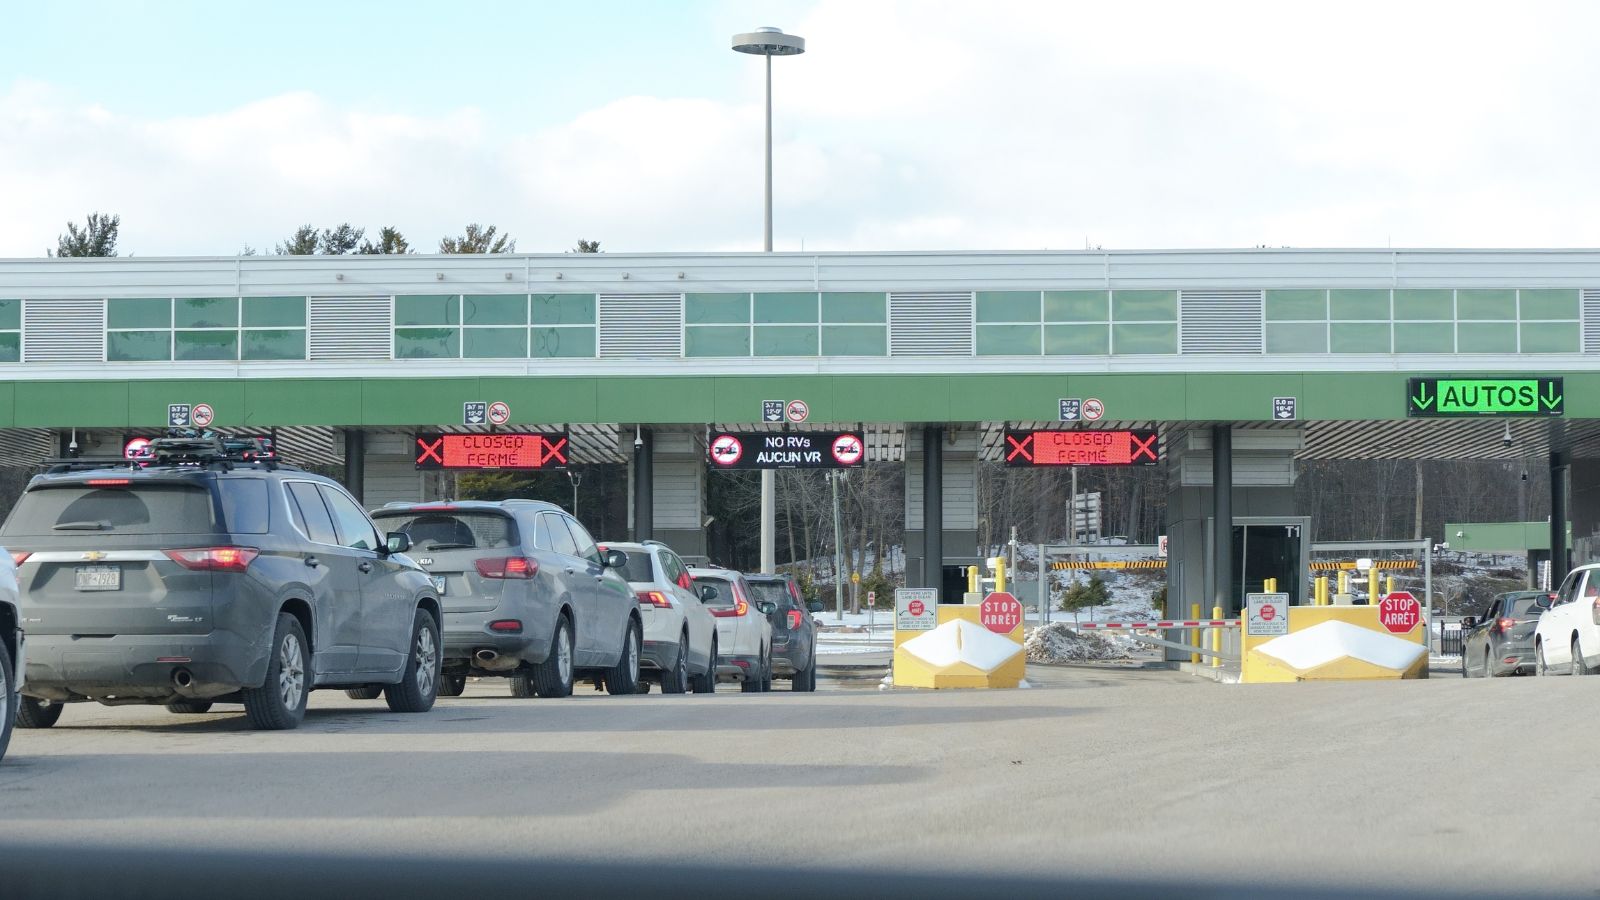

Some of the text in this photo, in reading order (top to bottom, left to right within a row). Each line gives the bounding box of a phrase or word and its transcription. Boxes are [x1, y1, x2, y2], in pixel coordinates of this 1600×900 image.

[1442, 385, 1535, 407] AUTOS
[463, 436, 524, 449] CLOSED
[765, 436, 811, 448] NO RVs
[1053, 433, 1113, 446] CLOSED
[467, 447, 519, 466] FERMÉ
[756, 451, 822, 464] AUCUN VR
[1058, 446, 1108, 462] FERMÉ
[1285, 525, 1301, 538] T1
[984, 601, 1017, 612] STOP
[1385, 598, 1414, 611] STOP
[984, 613, 1017, 625] ARRÊT
[1384, 611, 1416, 625] ARRÊT
